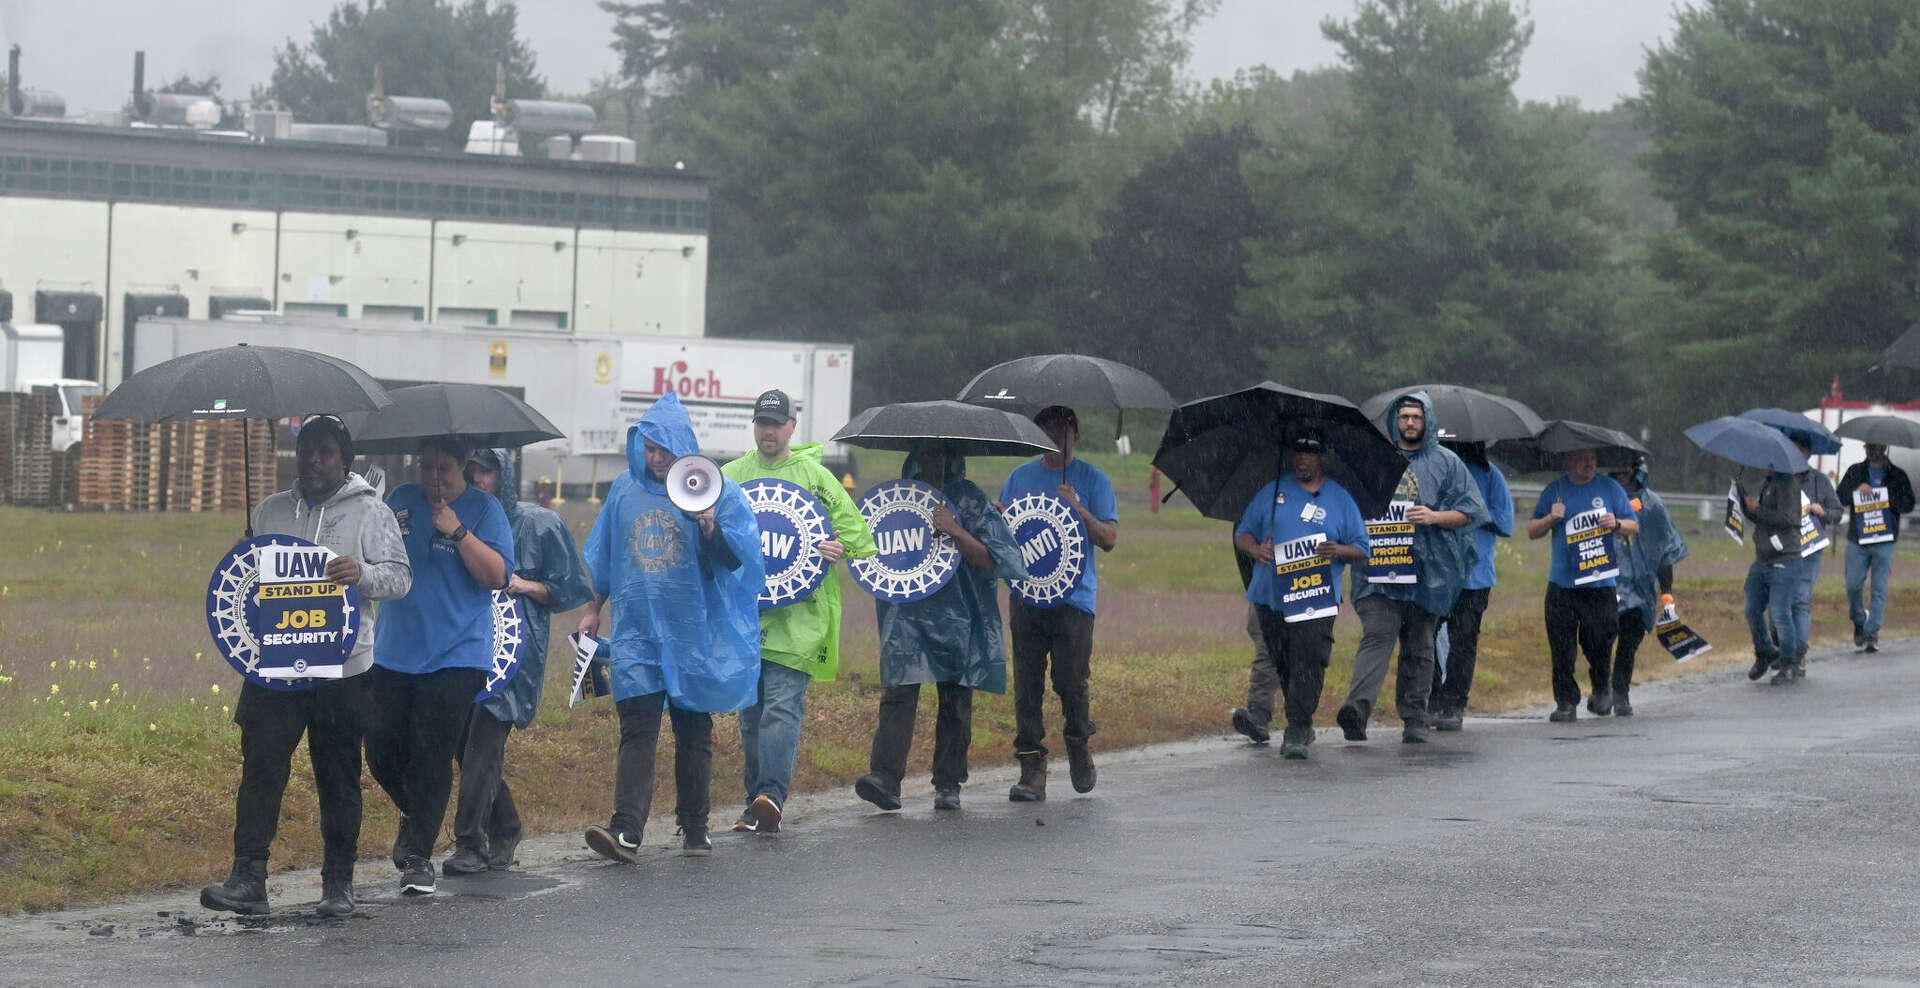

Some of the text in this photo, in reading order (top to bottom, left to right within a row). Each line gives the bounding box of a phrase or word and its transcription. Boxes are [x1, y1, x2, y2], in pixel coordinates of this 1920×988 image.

[653, 360, 722, 399] Koch
[1368, 526, 1398, 534] STAND
[1573, 512, 1600, 530] UAW
[760, 530, 796, 560] AW
[877, 527, 925, 556] UAW
[1019, 528, 1058, 568] UAW
[1284, 539, 1318, 560] UAW
[1579, 537, 1604, 551] SICK
[1373, 546, 1409, 556] PROFIT
[1580, 546, 1606, 561] TIME
[274, 552, 328, 578] UAW
[1280, 560, 1311, 573] STAND
[1369, 556, 1414, 566] SHARING
[1579, 555, 1610, 571] BANK
[265, 585, 337, 597] STAND UP
[1290, 573, 1322, 591] JOB
[1283, 585, 1331, 603] SECURITY
[275, 609, 327, 629] JOB
[262, 631, 338, 646] SECURITY
